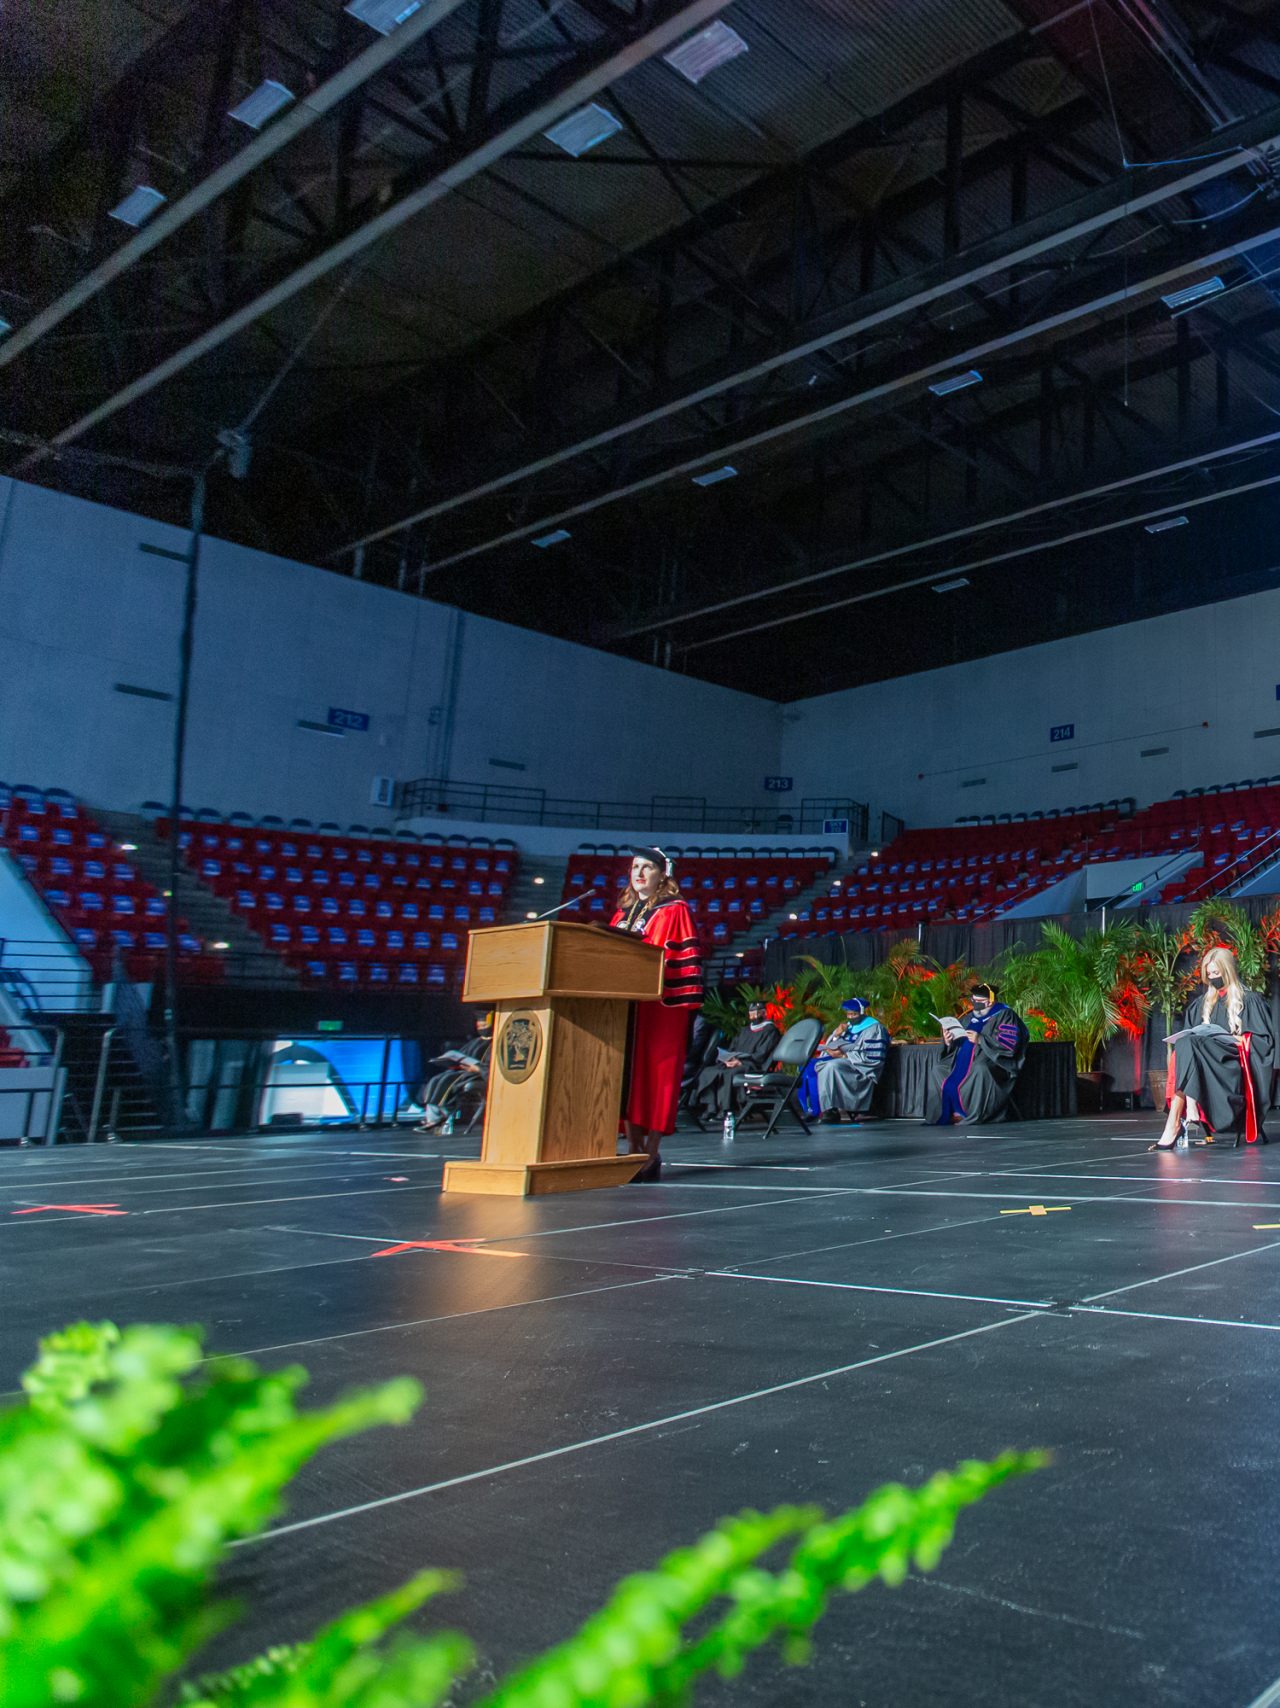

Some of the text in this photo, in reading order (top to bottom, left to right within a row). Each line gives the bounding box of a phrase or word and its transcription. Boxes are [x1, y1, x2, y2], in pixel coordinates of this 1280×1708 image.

[335, 711, 362, 728] 212
[1054, 727, 1070, 740] 214
[768, 779, 789, 789] 213
